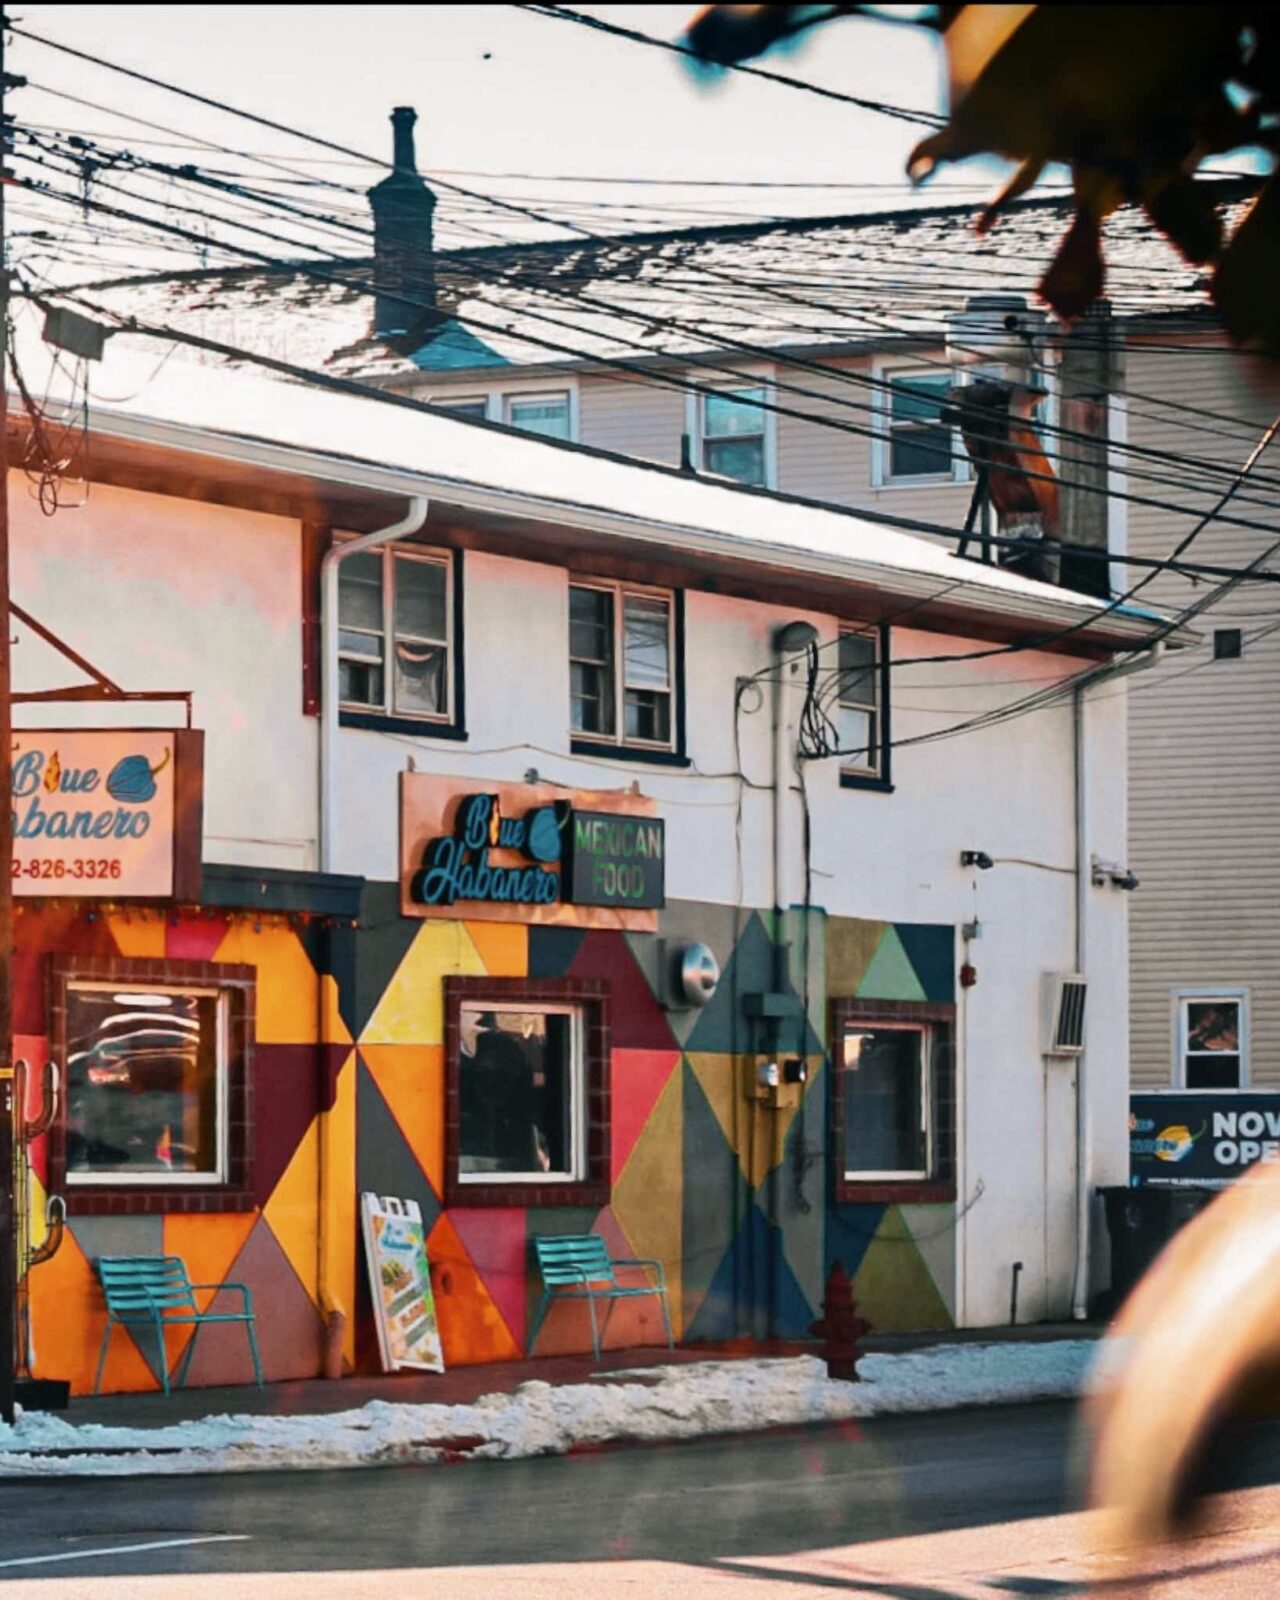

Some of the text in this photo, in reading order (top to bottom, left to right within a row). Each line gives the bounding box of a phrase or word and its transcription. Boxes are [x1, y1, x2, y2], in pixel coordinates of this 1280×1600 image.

[9, 858, 122, 879] 2-826-3326
[423, 838, 557, 904] Habanero
[591, 861, 645, 898] FOOD
[1213, 1140, 1280, 1165] OPE
